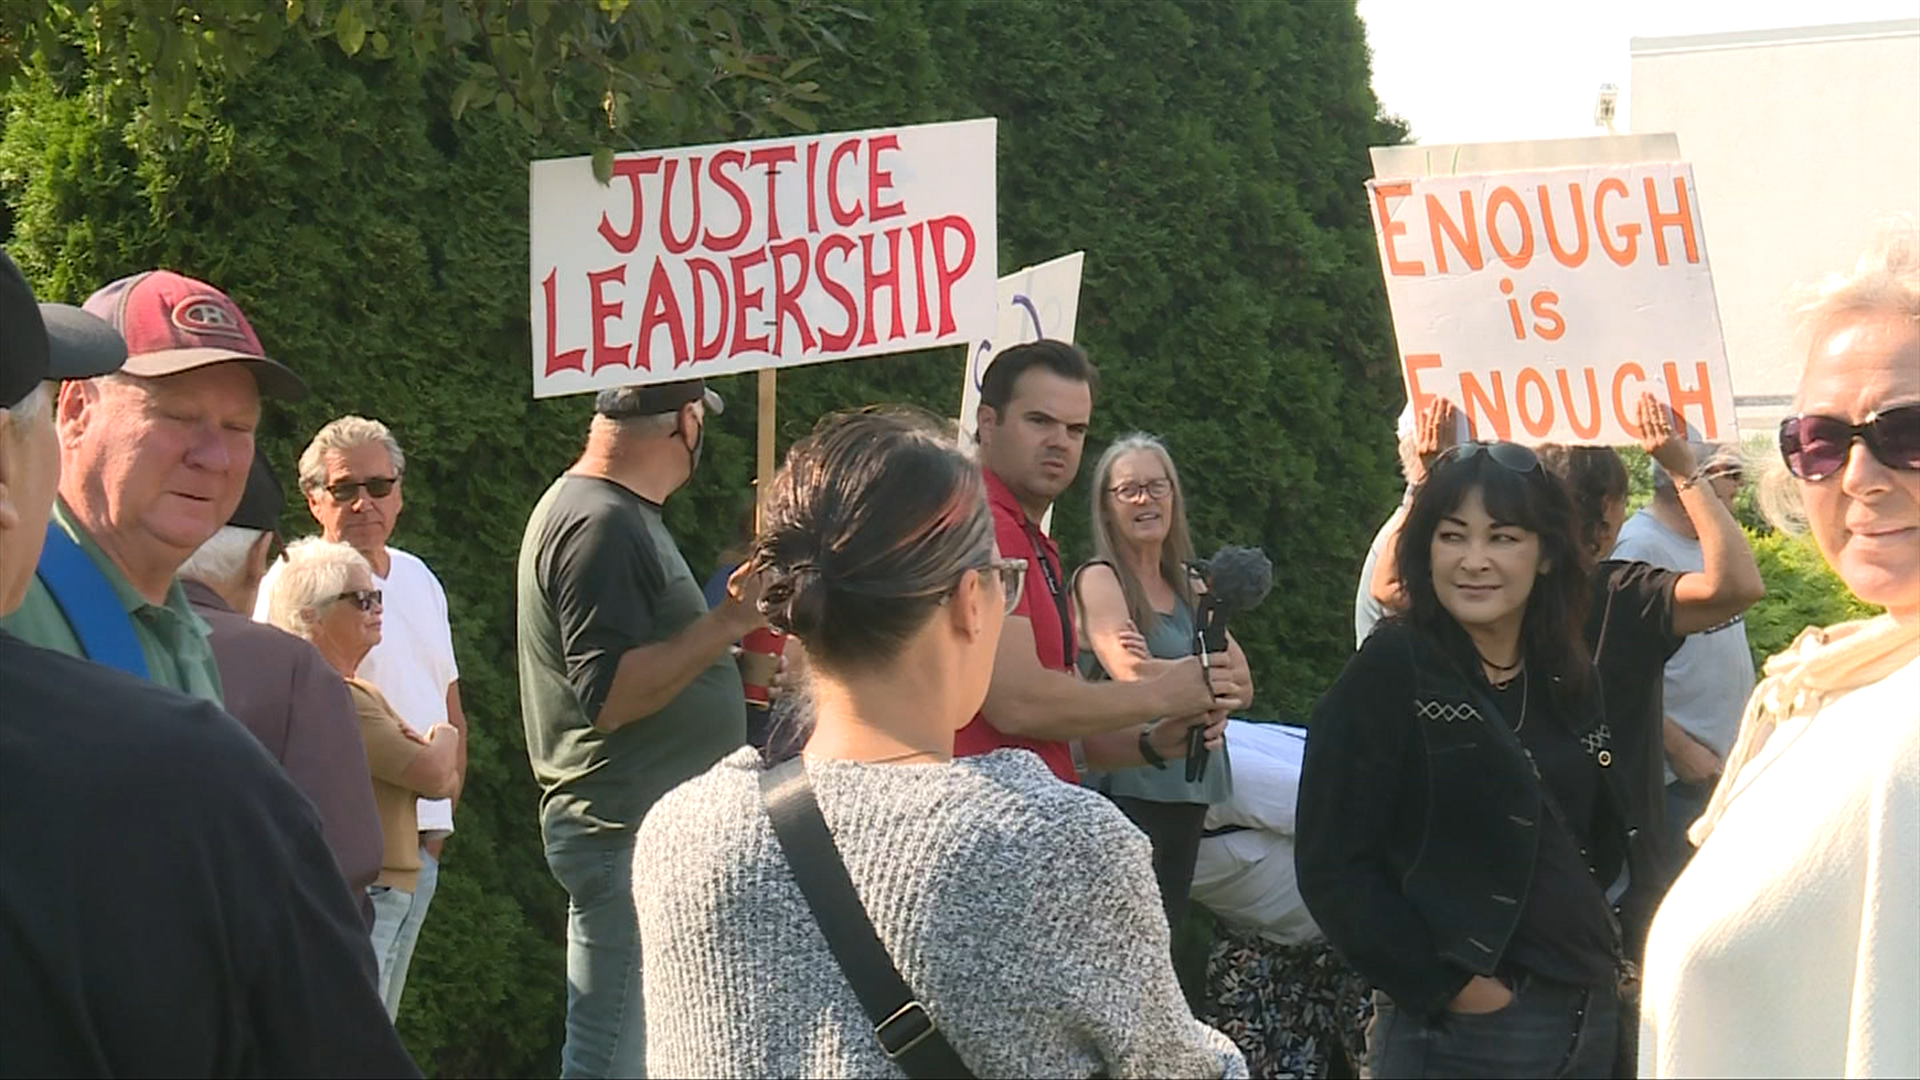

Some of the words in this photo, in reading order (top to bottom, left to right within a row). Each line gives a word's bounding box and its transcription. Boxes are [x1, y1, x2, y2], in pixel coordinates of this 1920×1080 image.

[598, 134, 907, 254] JUSTICE
[1374, 176, 1700, 276] ENOUGH
[543, 215, 977, 378] LEADERSHIP
[1499, 277, 1566, 341] is
